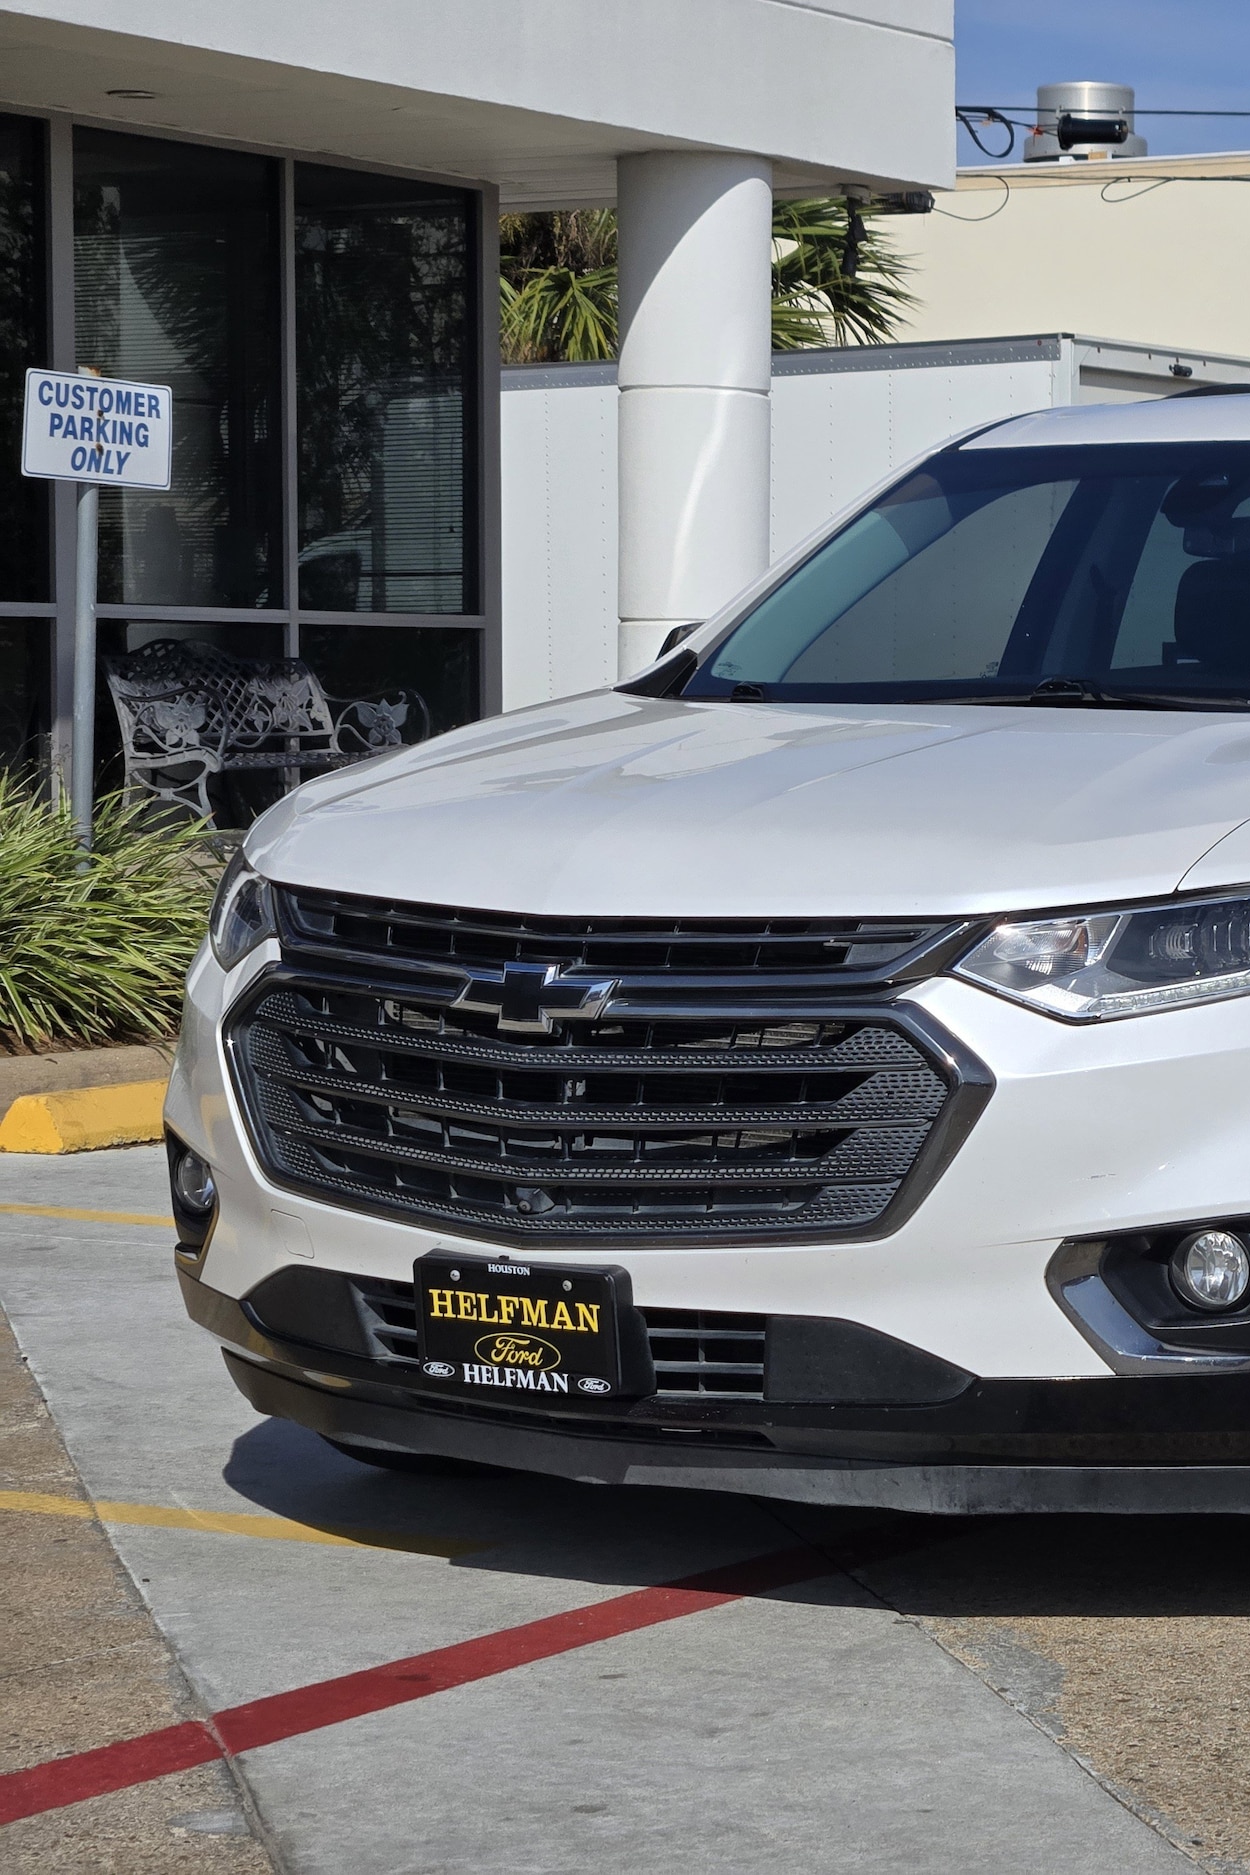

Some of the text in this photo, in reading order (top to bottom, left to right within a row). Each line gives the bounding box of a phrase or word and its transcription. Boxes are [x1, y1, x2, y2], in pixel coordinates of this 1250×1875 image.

[38, 380, 161, 419] CUSTOMER
[49, 412, 149, 448] PARKING
[71, 446, 131, 475] ONLY
[487, 1263, 531, 1276] HOUSTON
[428, 1288, 600, 1333] HELFMAN
[490, 1336, 543, 1367] Ford
[462, 1363, 569, 1394] HELFMAN
